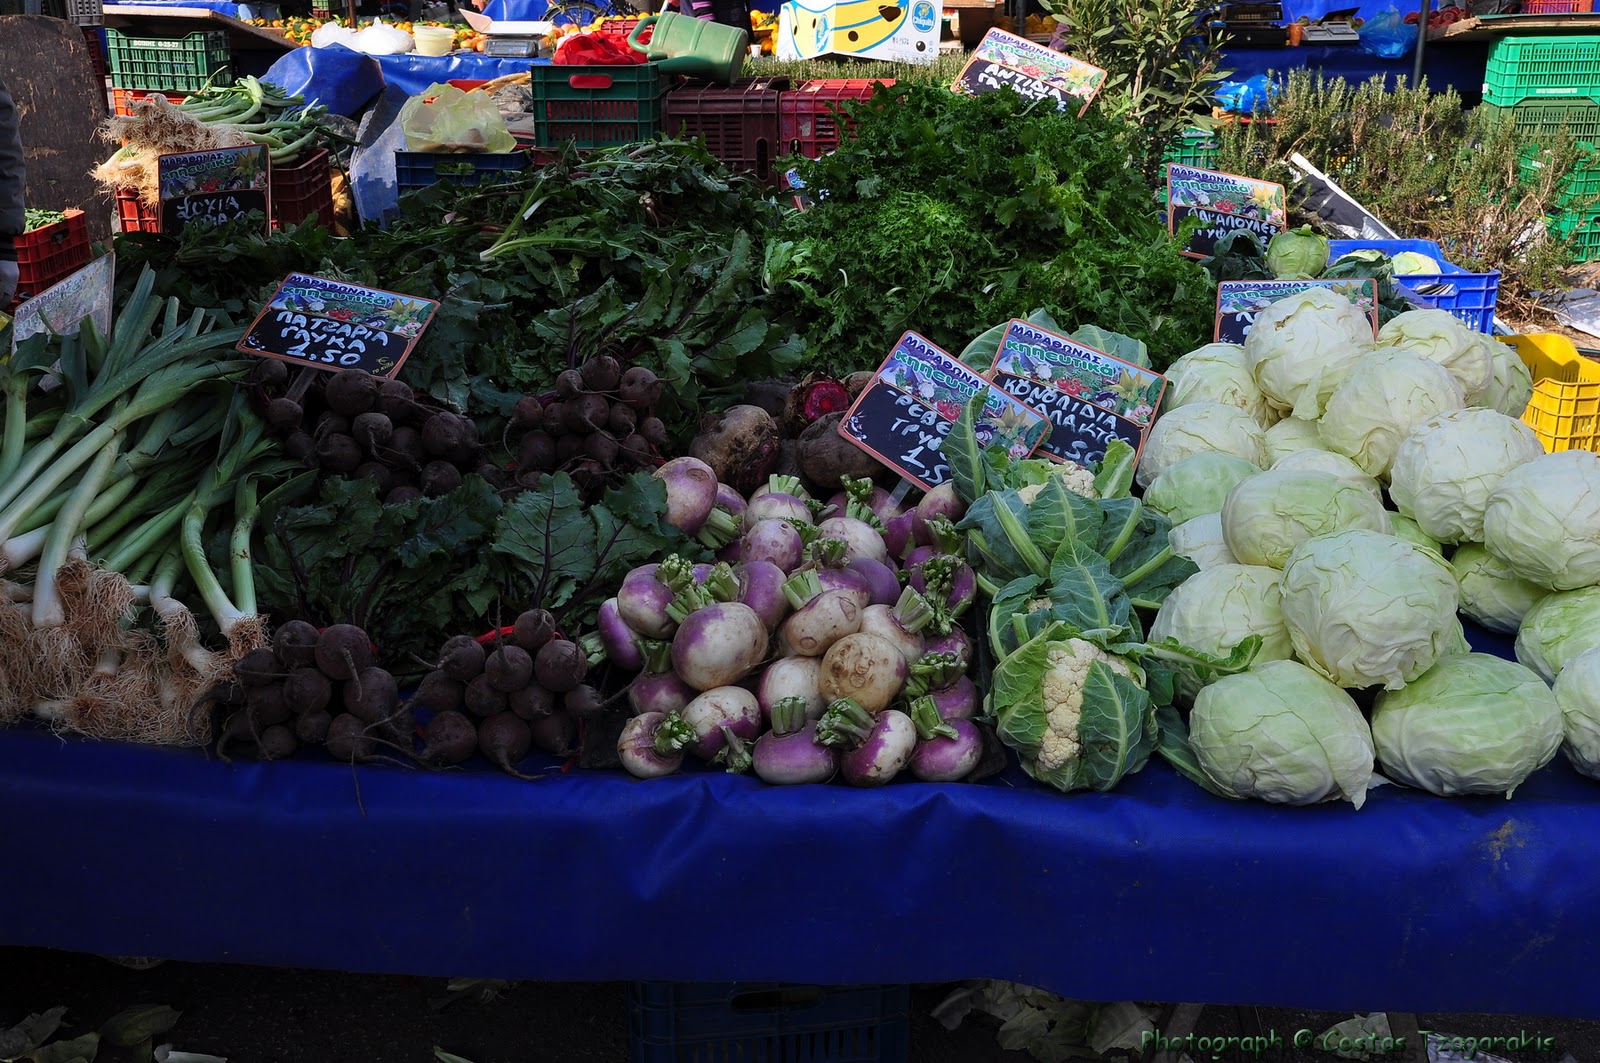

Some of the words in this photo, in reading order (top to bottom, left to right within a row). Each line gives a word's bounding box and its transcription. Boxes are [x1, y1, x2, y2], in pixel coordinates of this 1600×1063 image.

[990, 30, 1058, 61] ΜΑΡΑΘΩΝΑΣ
[161, 153, 223, 165] ΜΑΡΑΘΩΝΑΣ
[1171, 167, 1238, 185] ΜΑΡΑΘΩΝΑΣ
[288, 274, 377, 299] ΜΑΡΑΘΩΝΑΣ
[1223, 282, 1310, 290] ΜΑΡΑΘΩΝΑΣ
[276, 311, 389, 347] ΠΑΤΖΑΡΙΑ
[1011, 324, 1102, 365] ΜΑΡΑΘΩΝΑΣ
[895, 350, 998, 409] κηπευτιά
